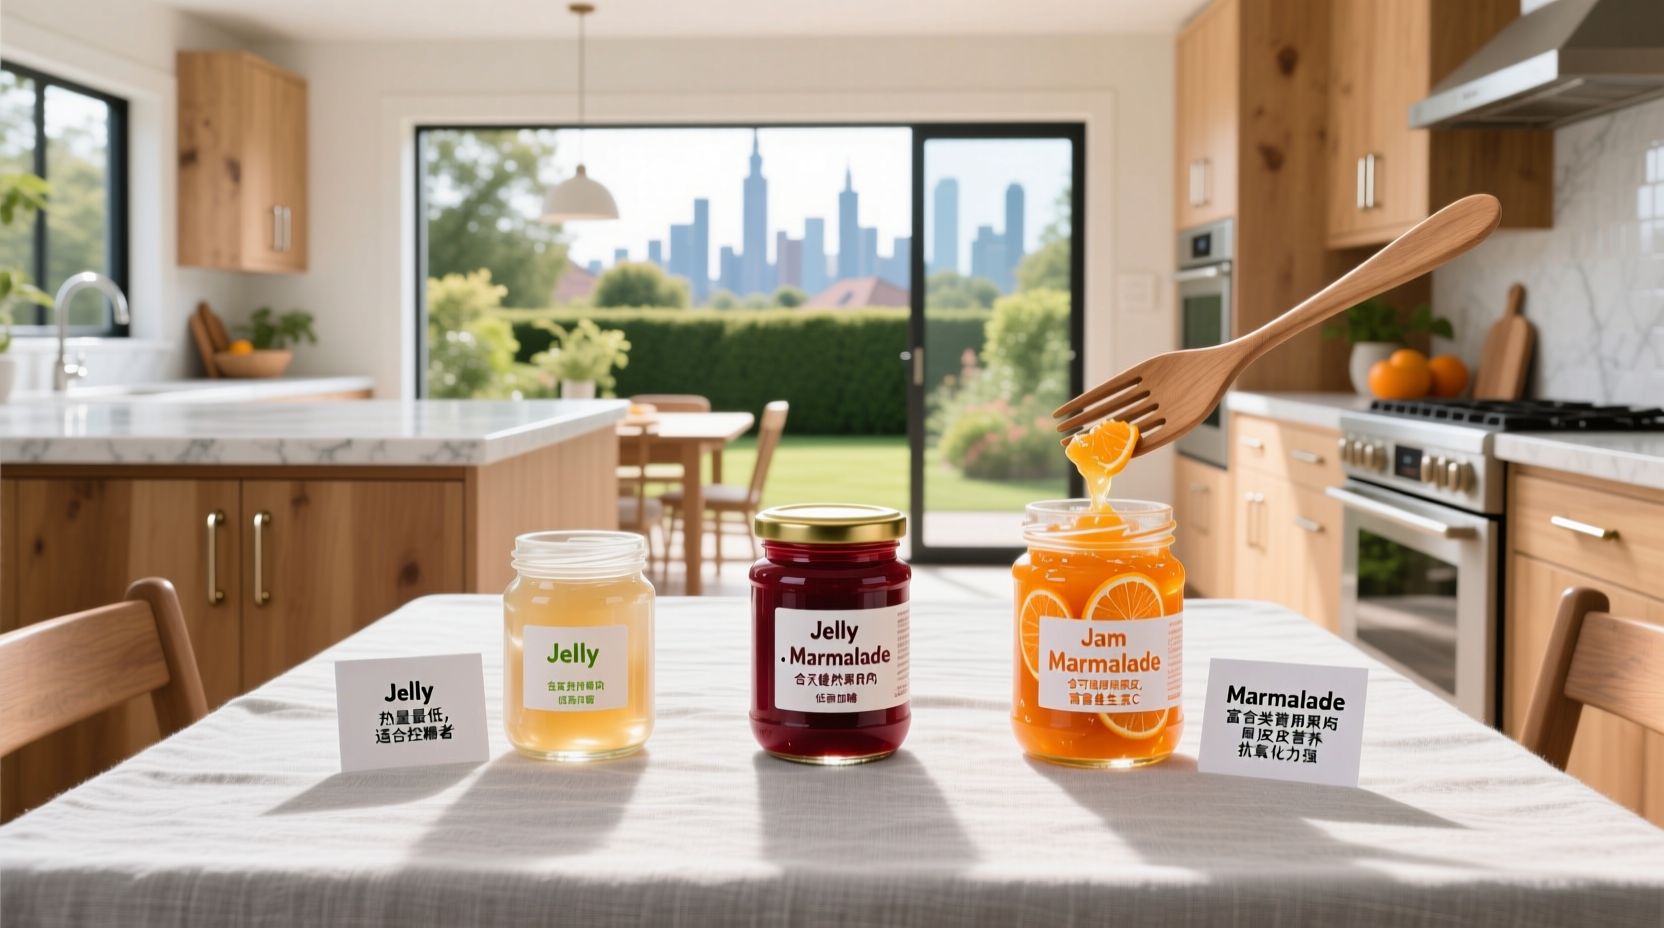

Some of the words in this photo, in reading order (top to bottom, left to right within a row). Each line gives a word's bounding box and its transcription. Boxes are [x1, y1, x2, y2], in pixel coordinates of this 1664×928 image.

[810, 619, 859, 645] Jelly
[1081, 627, 1127, 648] Jam
[546, 642, 600, 669] Jelly
[1048, 649, 1161, 674] Marmalade
[384, 680, 434, 705] Jelly
[1226, 684, 1346, 711] Marmalade
